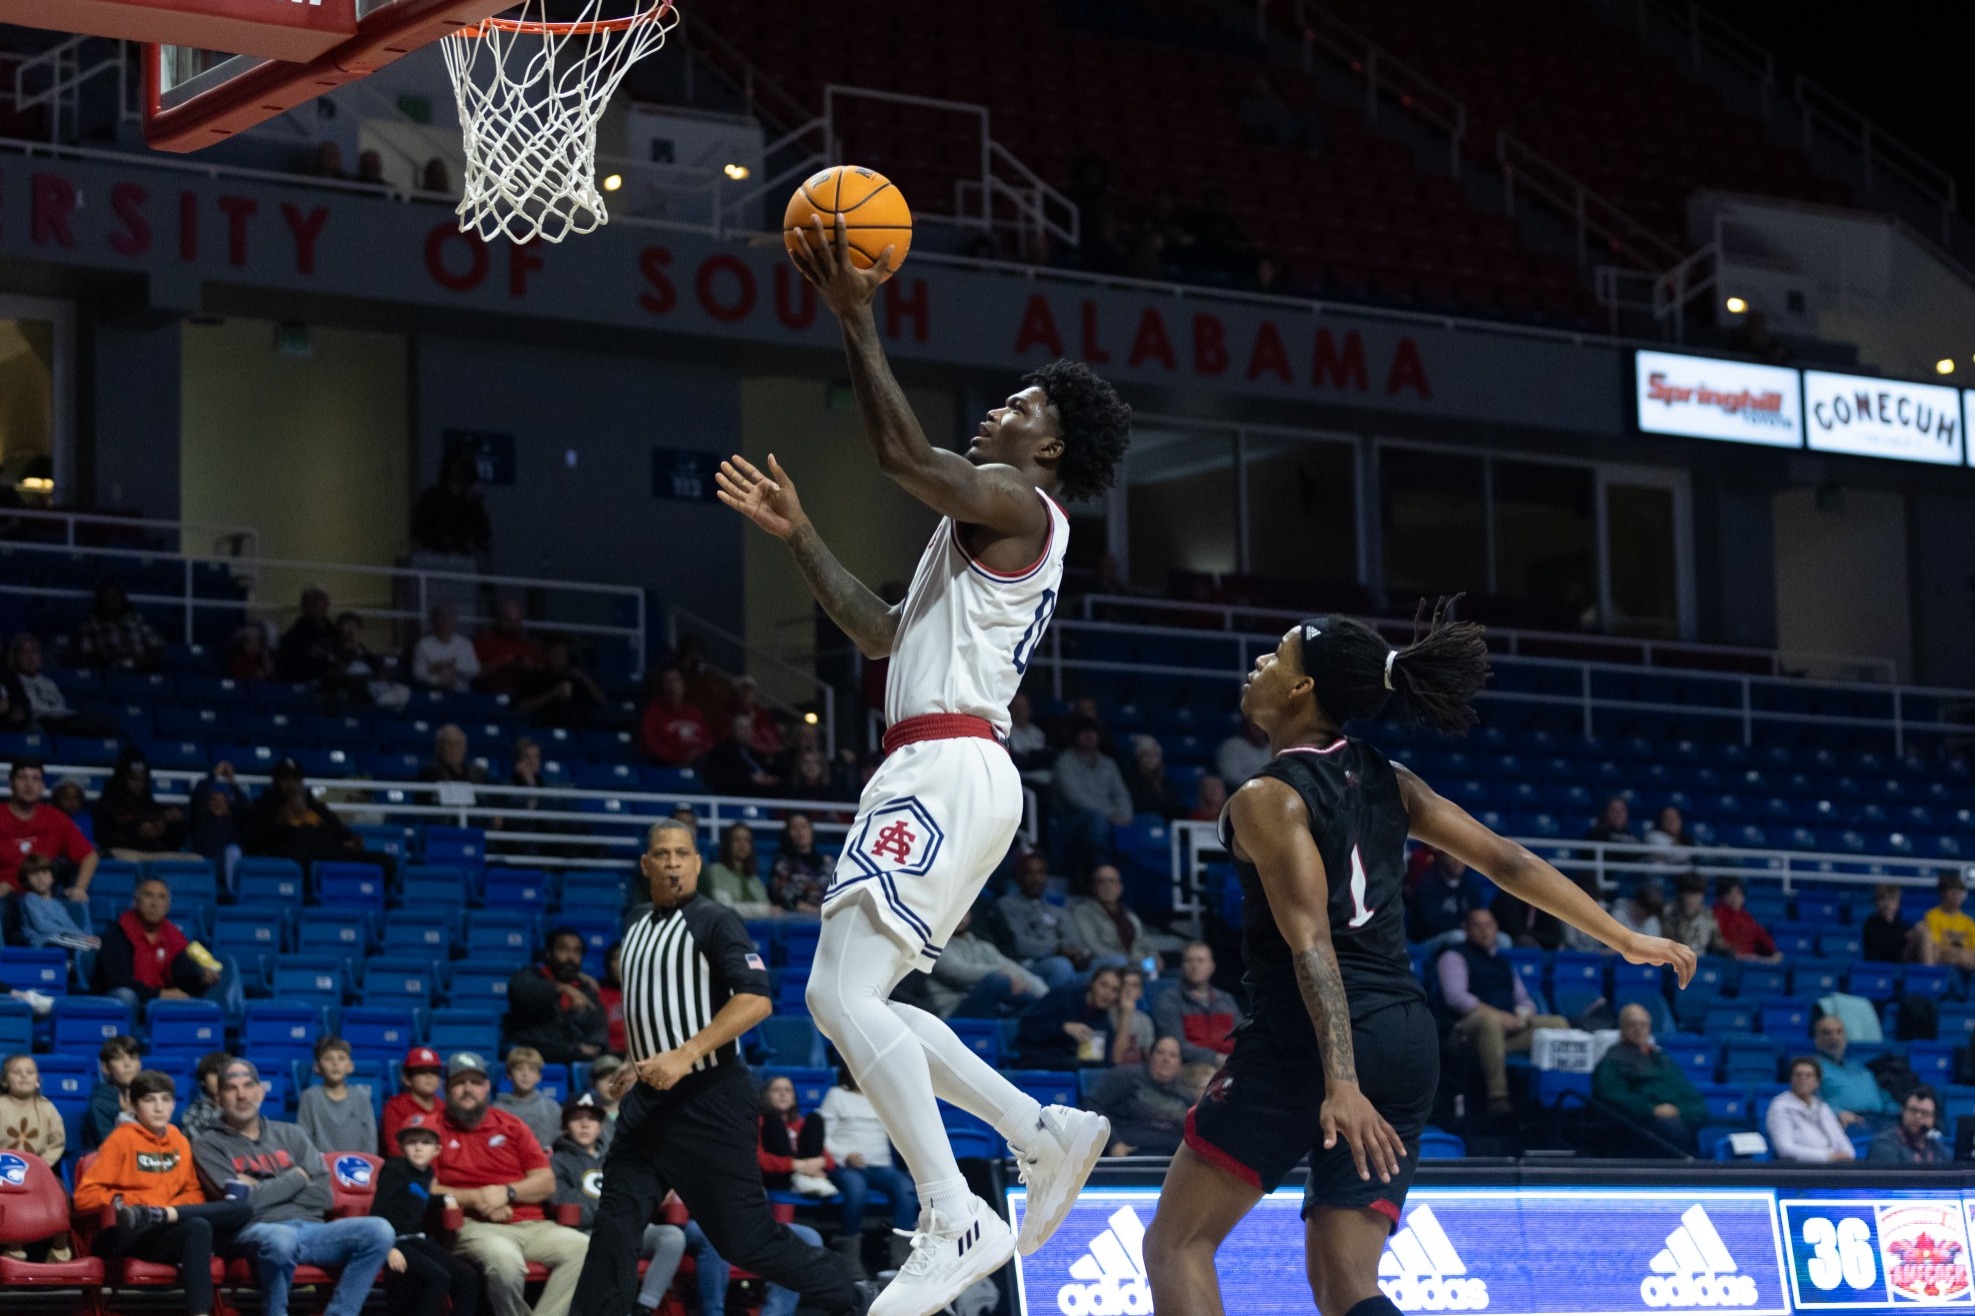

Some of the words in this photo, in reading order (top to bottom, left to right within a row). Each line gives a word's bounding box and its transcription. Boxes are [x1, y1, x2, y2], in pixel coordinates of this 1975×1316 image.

[0, 170, 329, 276] RSITY
[424, 219, 544, 298] OF
[638, 245, 930, 343] SOUH
[1014, 292, 1432, 400] ALABAMA
[1349, 842, 1374, 928] 1
[1640, 1271, 1759, 1307] adidas
[1802, 1216, 1877, 1291] 36
[1057, 1272, 1154, 1316] adid
